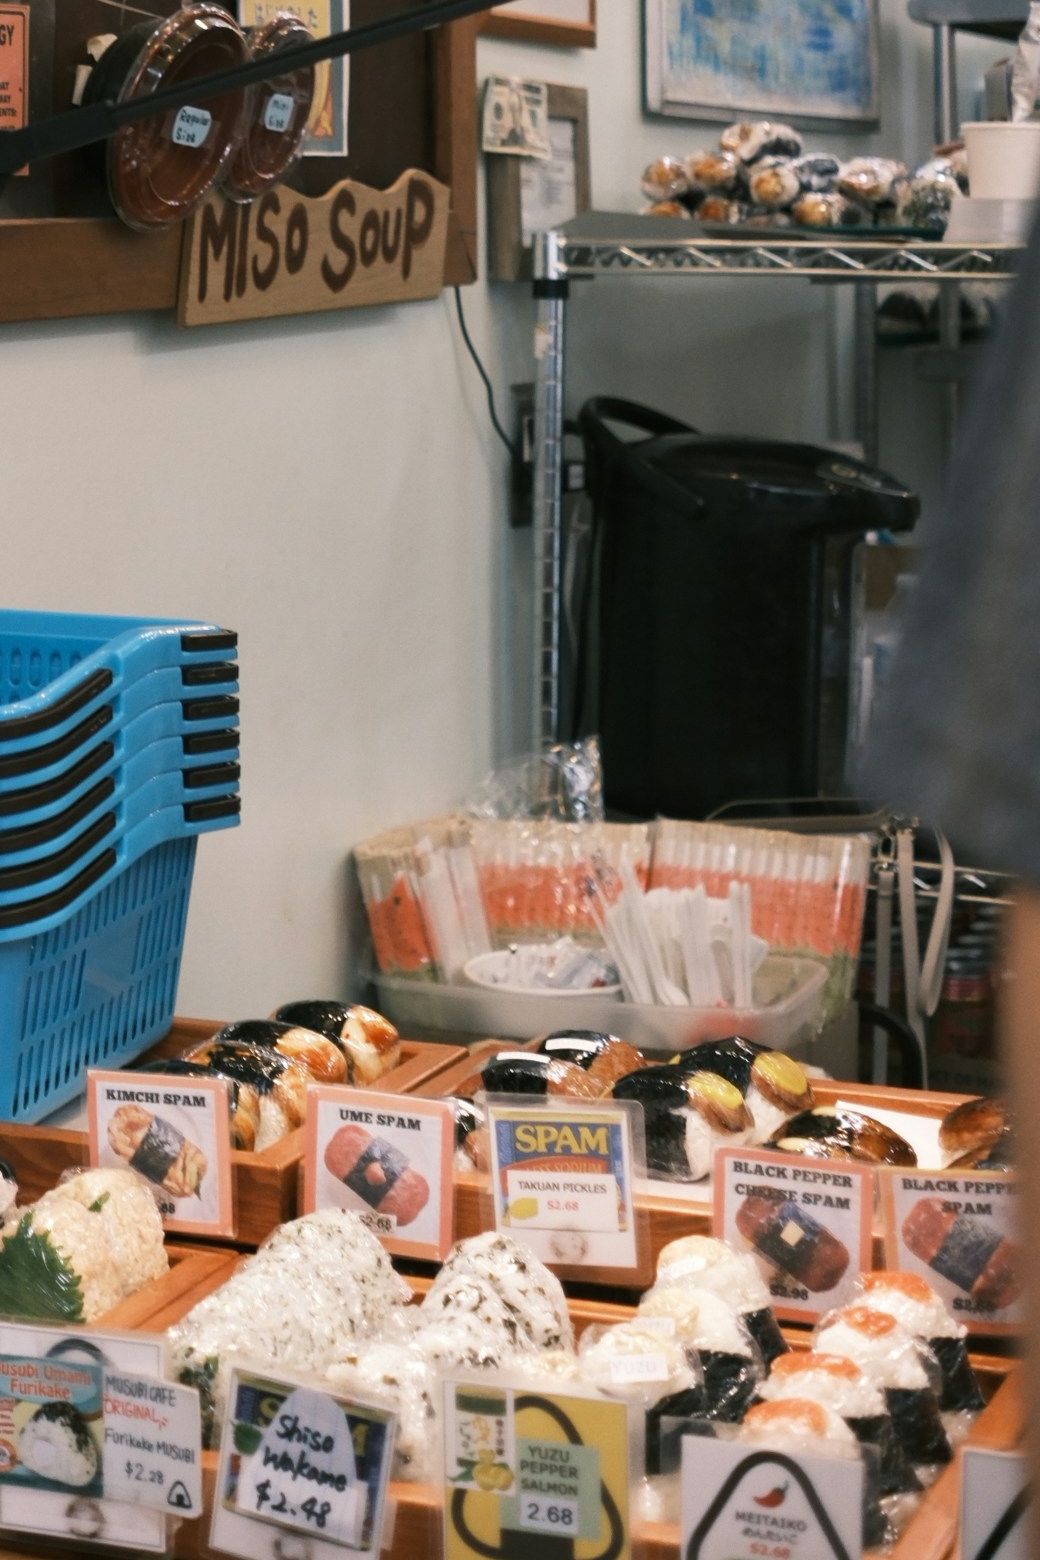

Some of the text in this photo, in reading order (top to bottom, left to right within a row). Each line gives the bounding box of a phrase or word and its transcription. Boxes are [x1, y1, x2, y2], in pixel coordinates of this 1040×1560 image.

[197, 178, 435, 304] MISO SOUP
[106, 1088, 207, 1109] KIMCHI SPAM
[339, 1108, 422, 1132] UME SPAM
[515, 1124, 609, 1155] SPAM
[517, 1180, 608, 1194] TAKUAN PICKLES
[733, 1160, 853, 1189] BLACK PEPPER
[902, 1177, 959, 1194] BLACK
[546, 1199, 580, 1212] $2.68
[734, 1183, 851, 1211] CHEESE SPAM
[942, 1201, 993, 1215] SPAM
[10, 1378, 71, 1400] Furikake
[105, 1375, 177, 1408] MUSUBI CAFE
[106, 1397, 160, 1425] ORIGINAL
[105, 1427, 196, 1465] Furikake MUSUBI
[276, 1414, 334, 1453] Shiso
[527, 1445, 570, 1463] YUZU
[124, 1459, 165, 1486] $2.28
[262, 1445, 347, 1492] Wakame
[520, 1460, 579, 1479] PEPPER
[520, 1478, 579, 1496] SALMON
[256, 1479, 331, 1528] $2.48
[527, 1502, 573, 1525] 2.68
